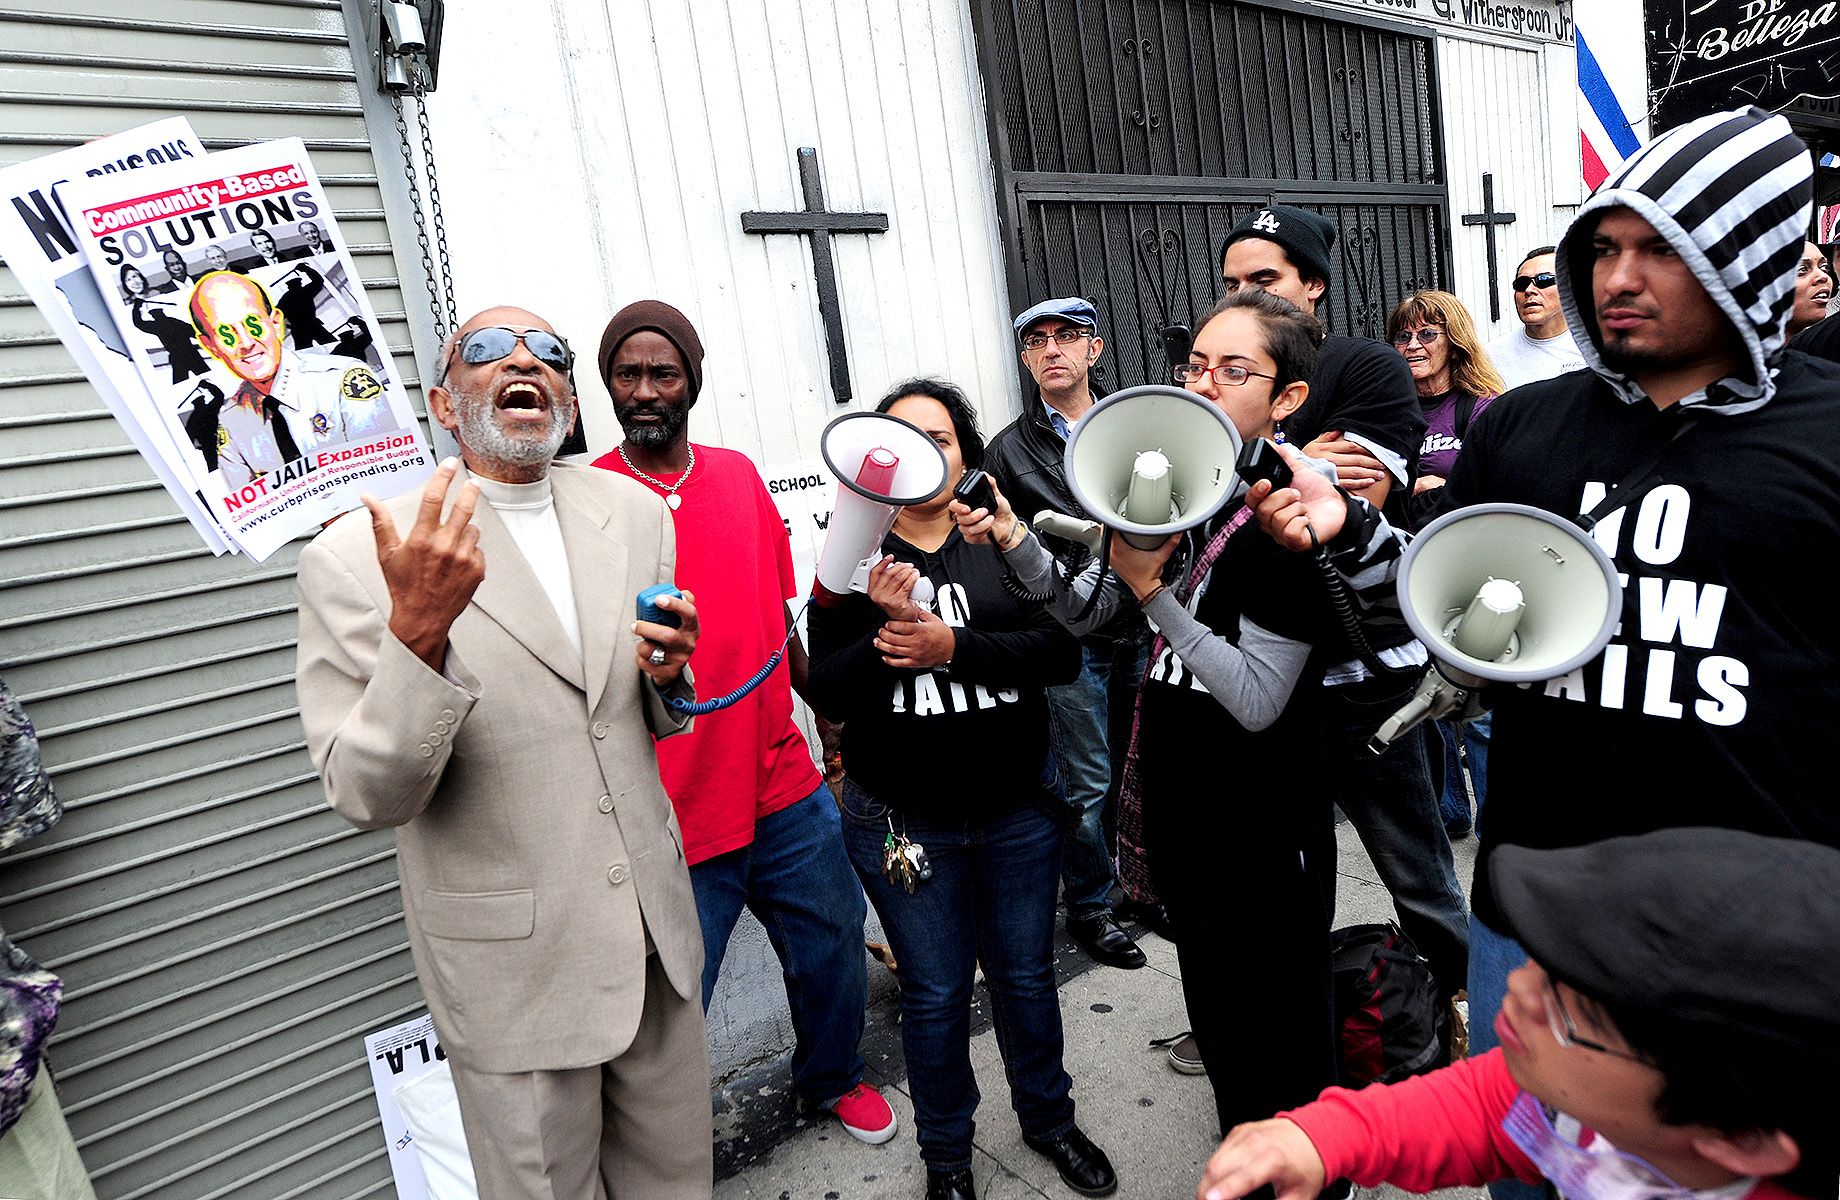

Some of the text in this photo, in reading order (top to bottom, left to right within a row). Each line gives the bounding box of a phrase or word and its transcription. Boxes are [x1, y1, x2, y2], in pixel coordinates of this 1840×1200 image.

[1460, 0, 1552, 35] Witherspoon
[1697, 1, 1837, 61] Belleza
[10, 179, 79, 263] N
[85, 162, 307, 234] Community-Based
[99, 190, 320, 266] SOLUTIONS
[1252, 210, 1281, 234] LA
[223, 434, 415, 513] NOT JAIL Expansion
[238, 456, 425, 534] www.curbprisonspending.org
[279, 480, 307, 497] United
[327, 455, 384, 474] Responsible
[386, 446, 420, 460] Budget
[768, 474, 827, 494] SCHOOL
